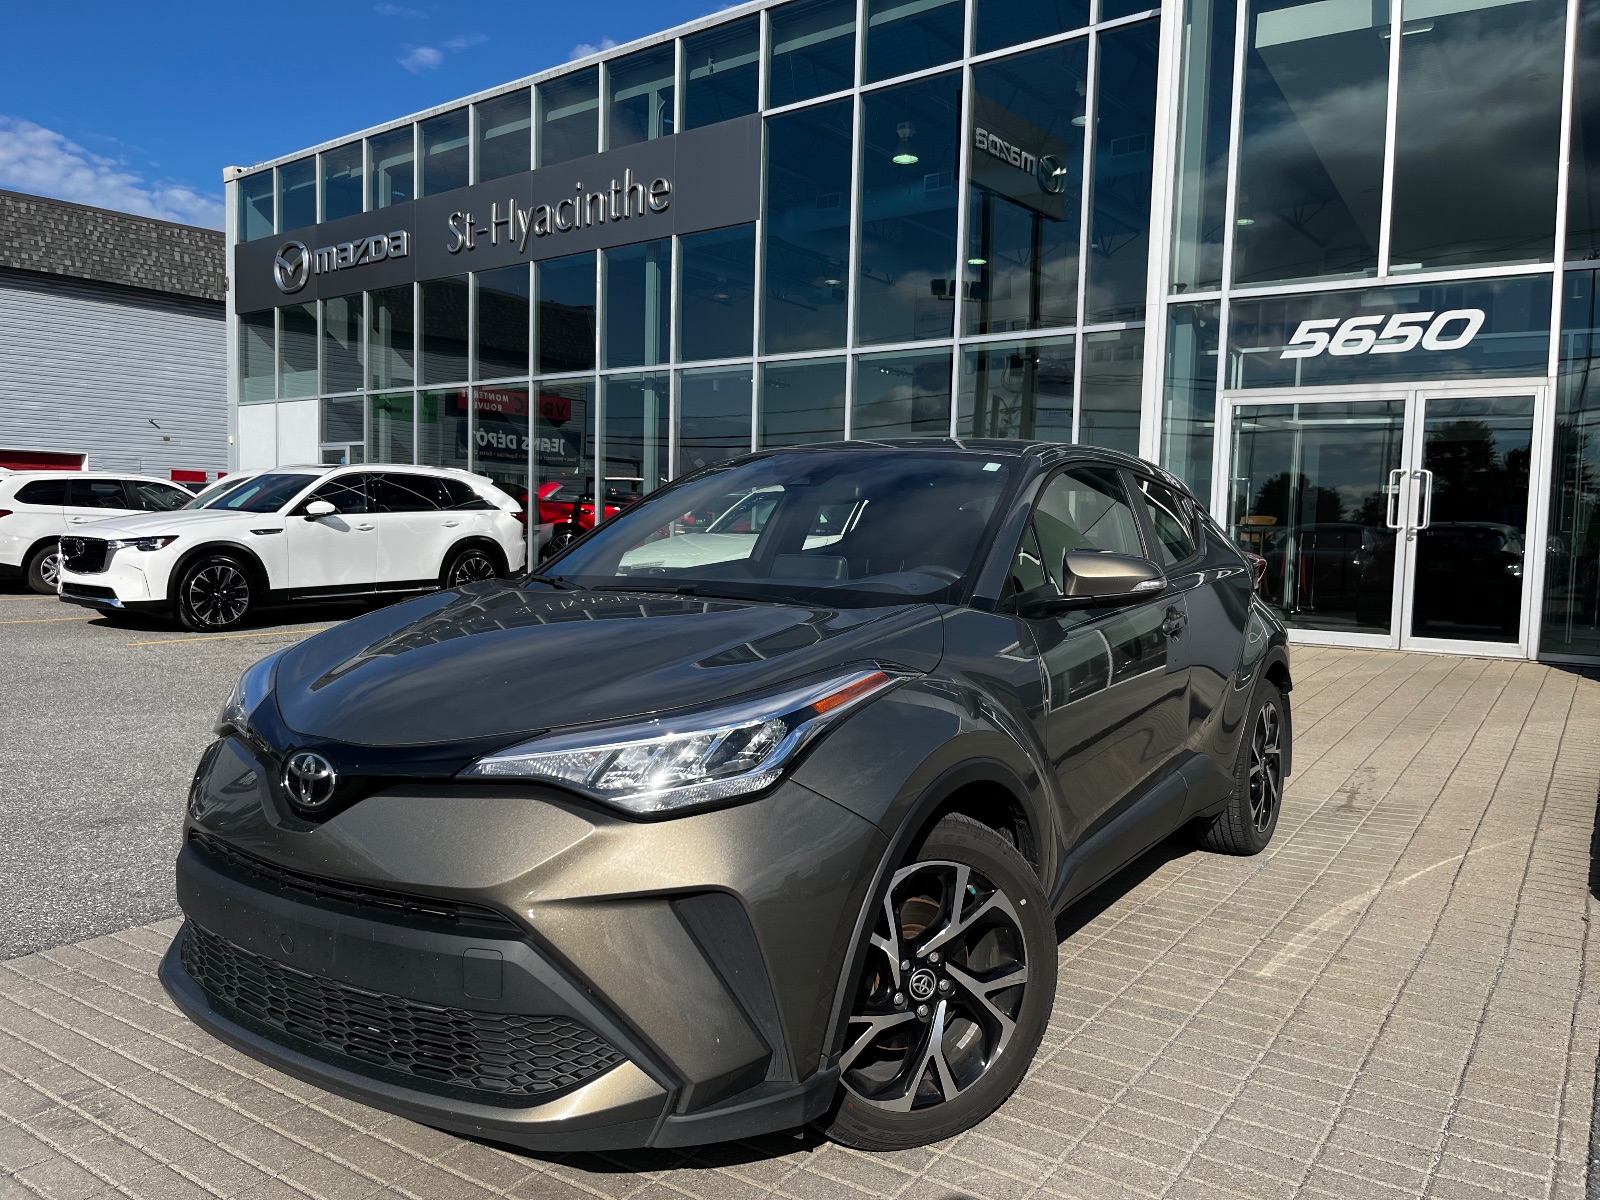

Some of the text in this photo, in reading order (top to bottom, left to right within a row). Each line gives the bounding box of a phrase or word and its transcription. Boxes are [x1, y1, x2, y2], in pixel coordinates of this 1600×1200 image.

[446, 167, 672, 254] St-Hyacinthe
[314, 229, 409, 274] mazda
[1279, 308, 1486, 360] 5650
